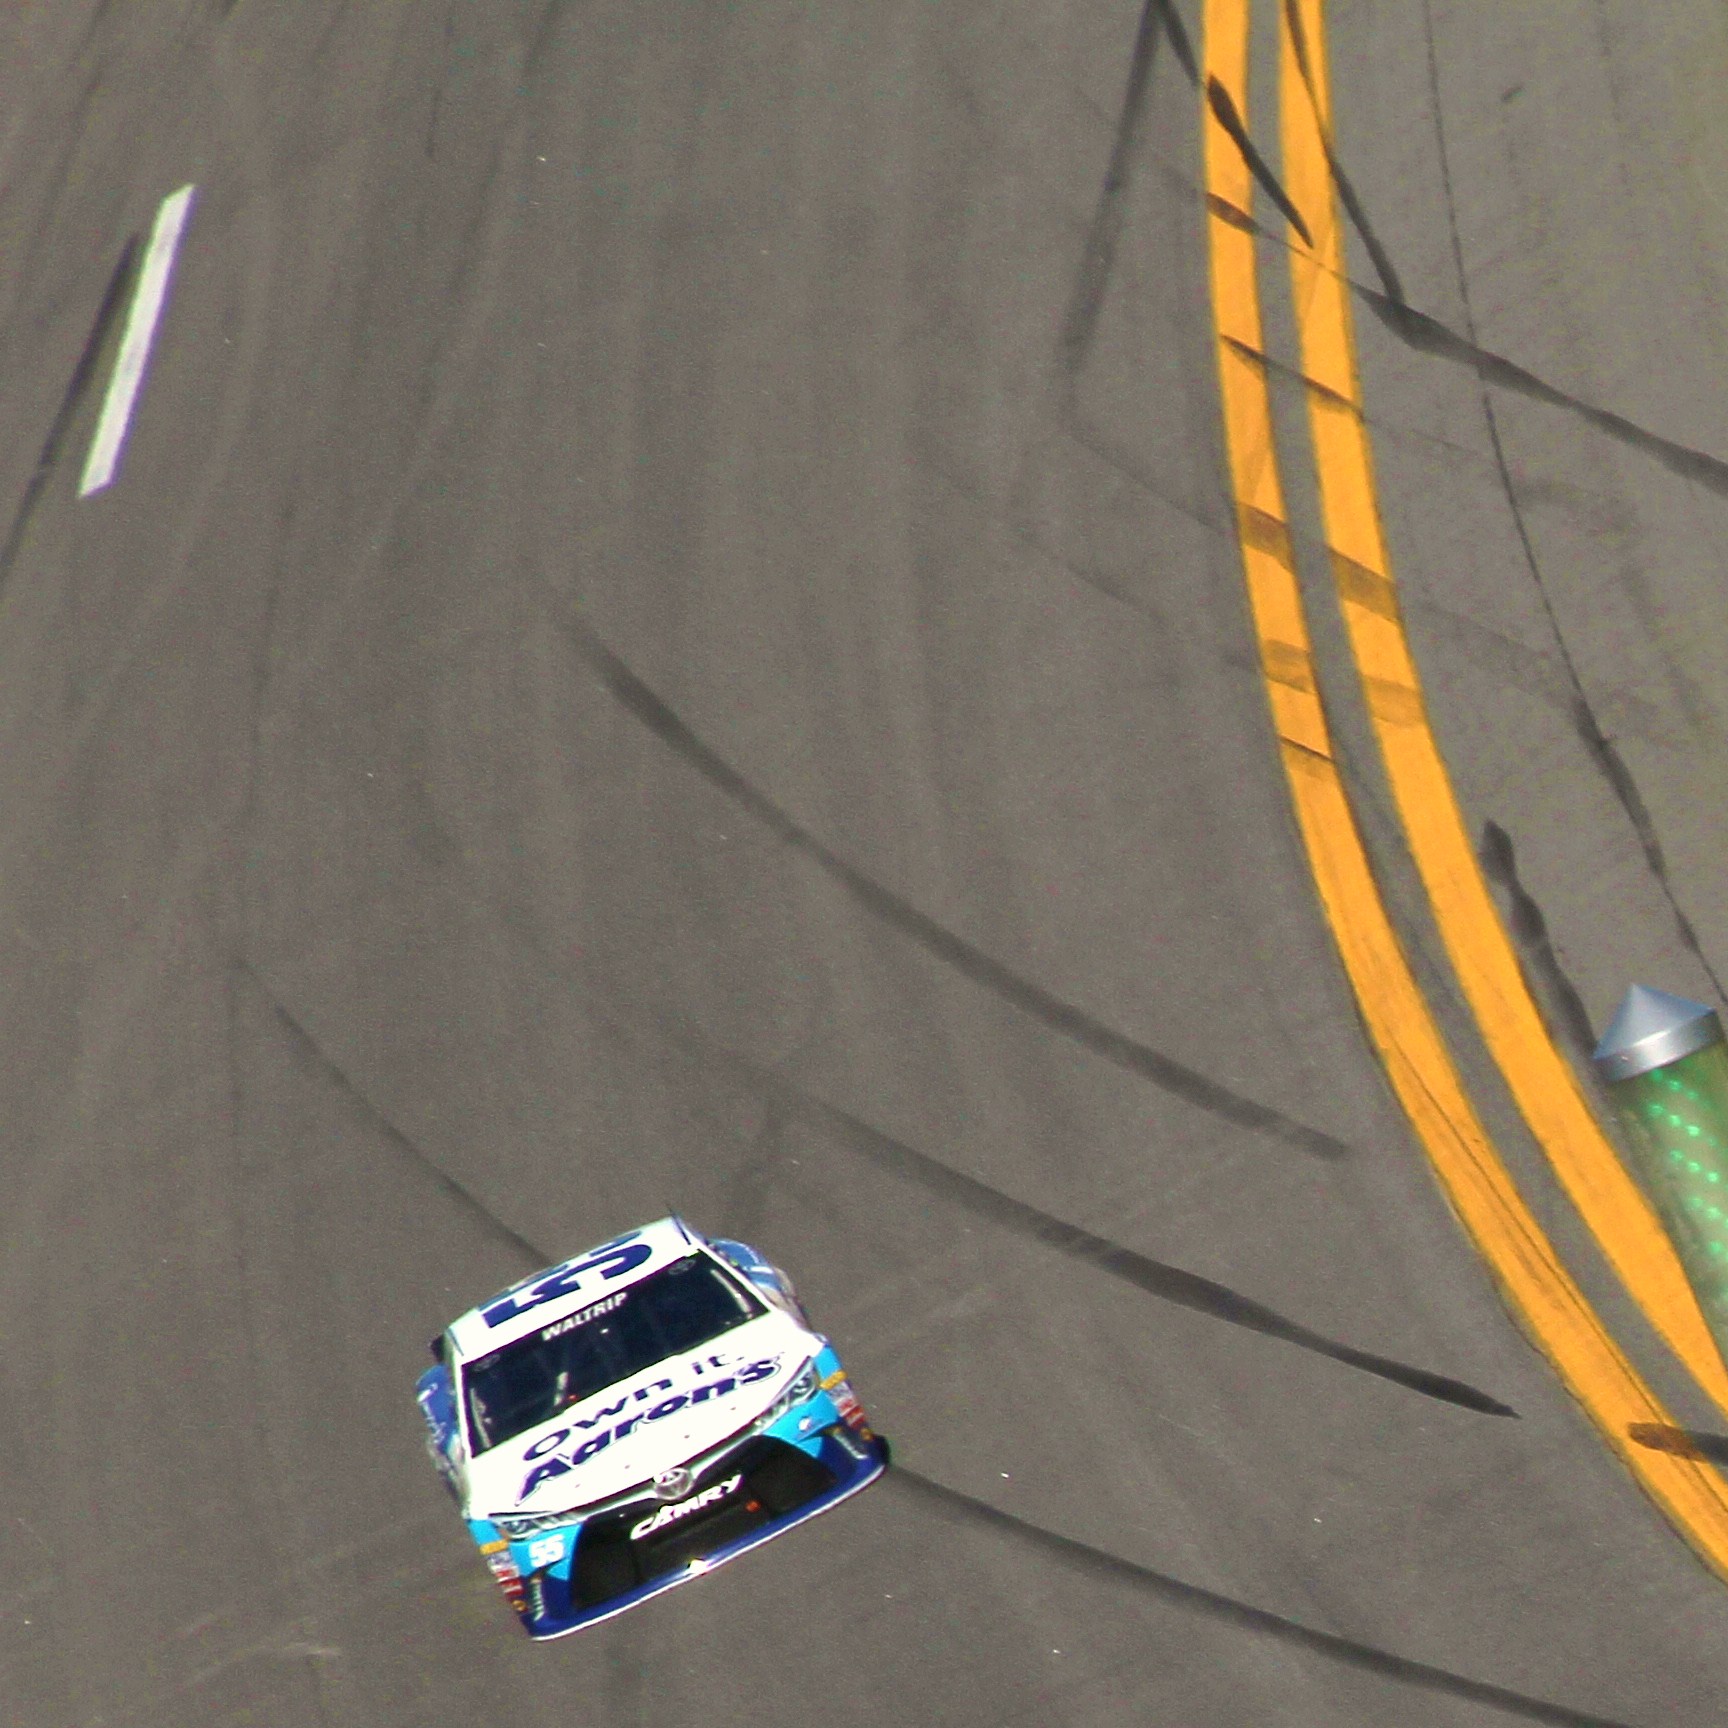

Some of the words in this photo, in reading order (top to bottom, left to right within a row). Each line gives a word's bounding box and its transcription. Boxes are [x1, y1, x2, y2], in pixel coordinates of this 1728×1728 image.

[541, 1292, 628, 1341] WALTRIP
[523, 1379, 673, 1461] Own
[630, 1473, 743, 1540] CAMRY
[529, 1533, 565, 1567] 55
